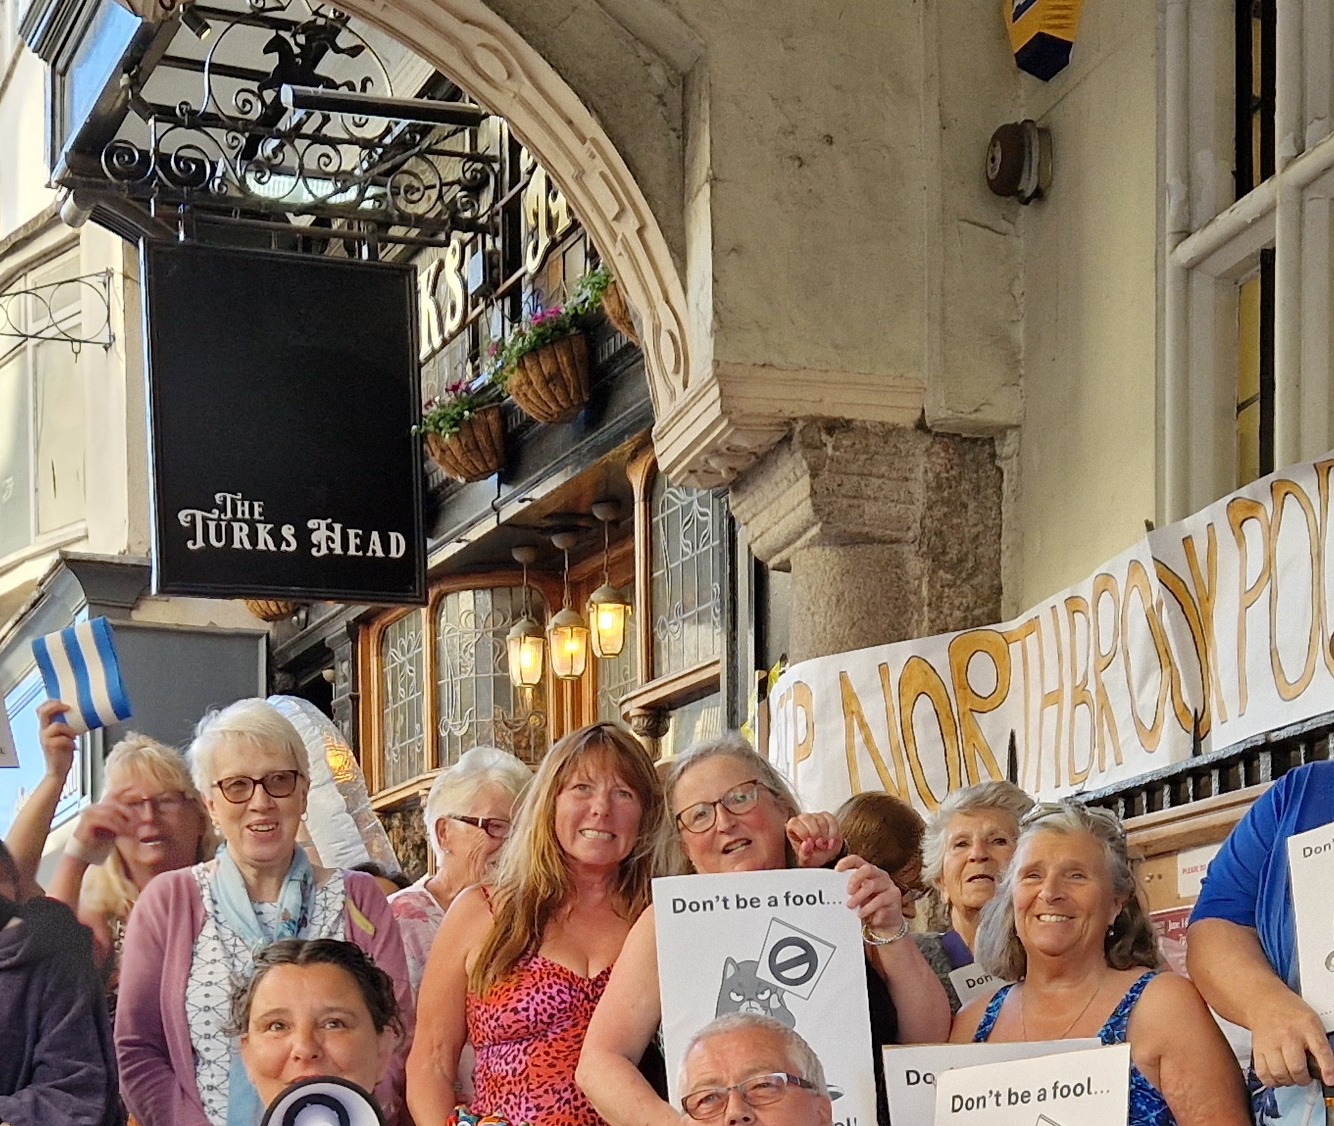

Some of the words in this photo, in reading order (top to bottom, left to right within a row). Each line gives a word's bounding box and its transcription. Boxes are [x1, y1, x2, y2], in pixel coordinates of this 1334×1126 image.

[177, 508, 298, 552] TURKS
[306, 518, 406, 558] HEAD
[671, 895, 730, 914] Don't
[735, 894, 762, 910] be
[767, 894, 779, 907] a
[783, 890, 843, 907] fool...
[965, 974, 993, 989] Don
[950, 1089, 1002, 1113] Don't
[1007, 1088, 1032, 1106] be
[1036, 1088, 1047, 1102] a
[1051, 1076, 1110, 1100] fool...
